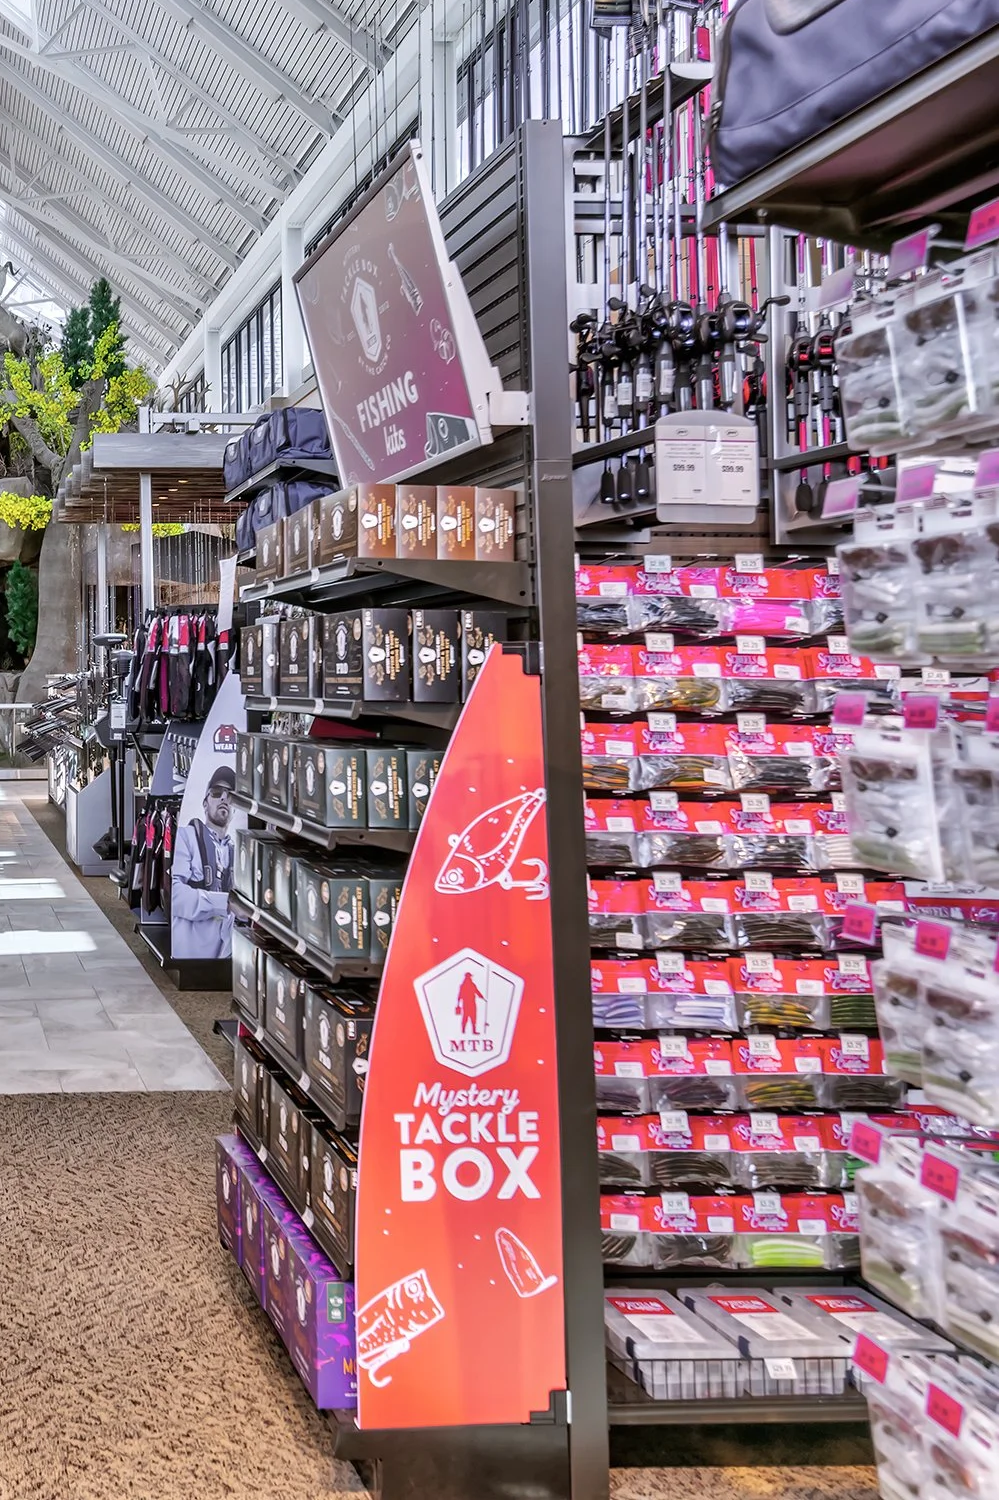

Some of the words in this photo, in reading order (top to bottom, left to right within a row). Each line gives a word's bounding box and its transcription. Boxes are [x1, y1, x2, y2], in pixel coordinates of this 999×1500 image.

[356, 370, 419, 432] FISHING
[384, 426, 406, 456] kits
[450, 1038, 494, 1052] MTB
[414, 1082, 520, 1117] Mystery
[394, 1112, 540, 1145] TACKLE
[400, 1146, 541, 1202] BOX
